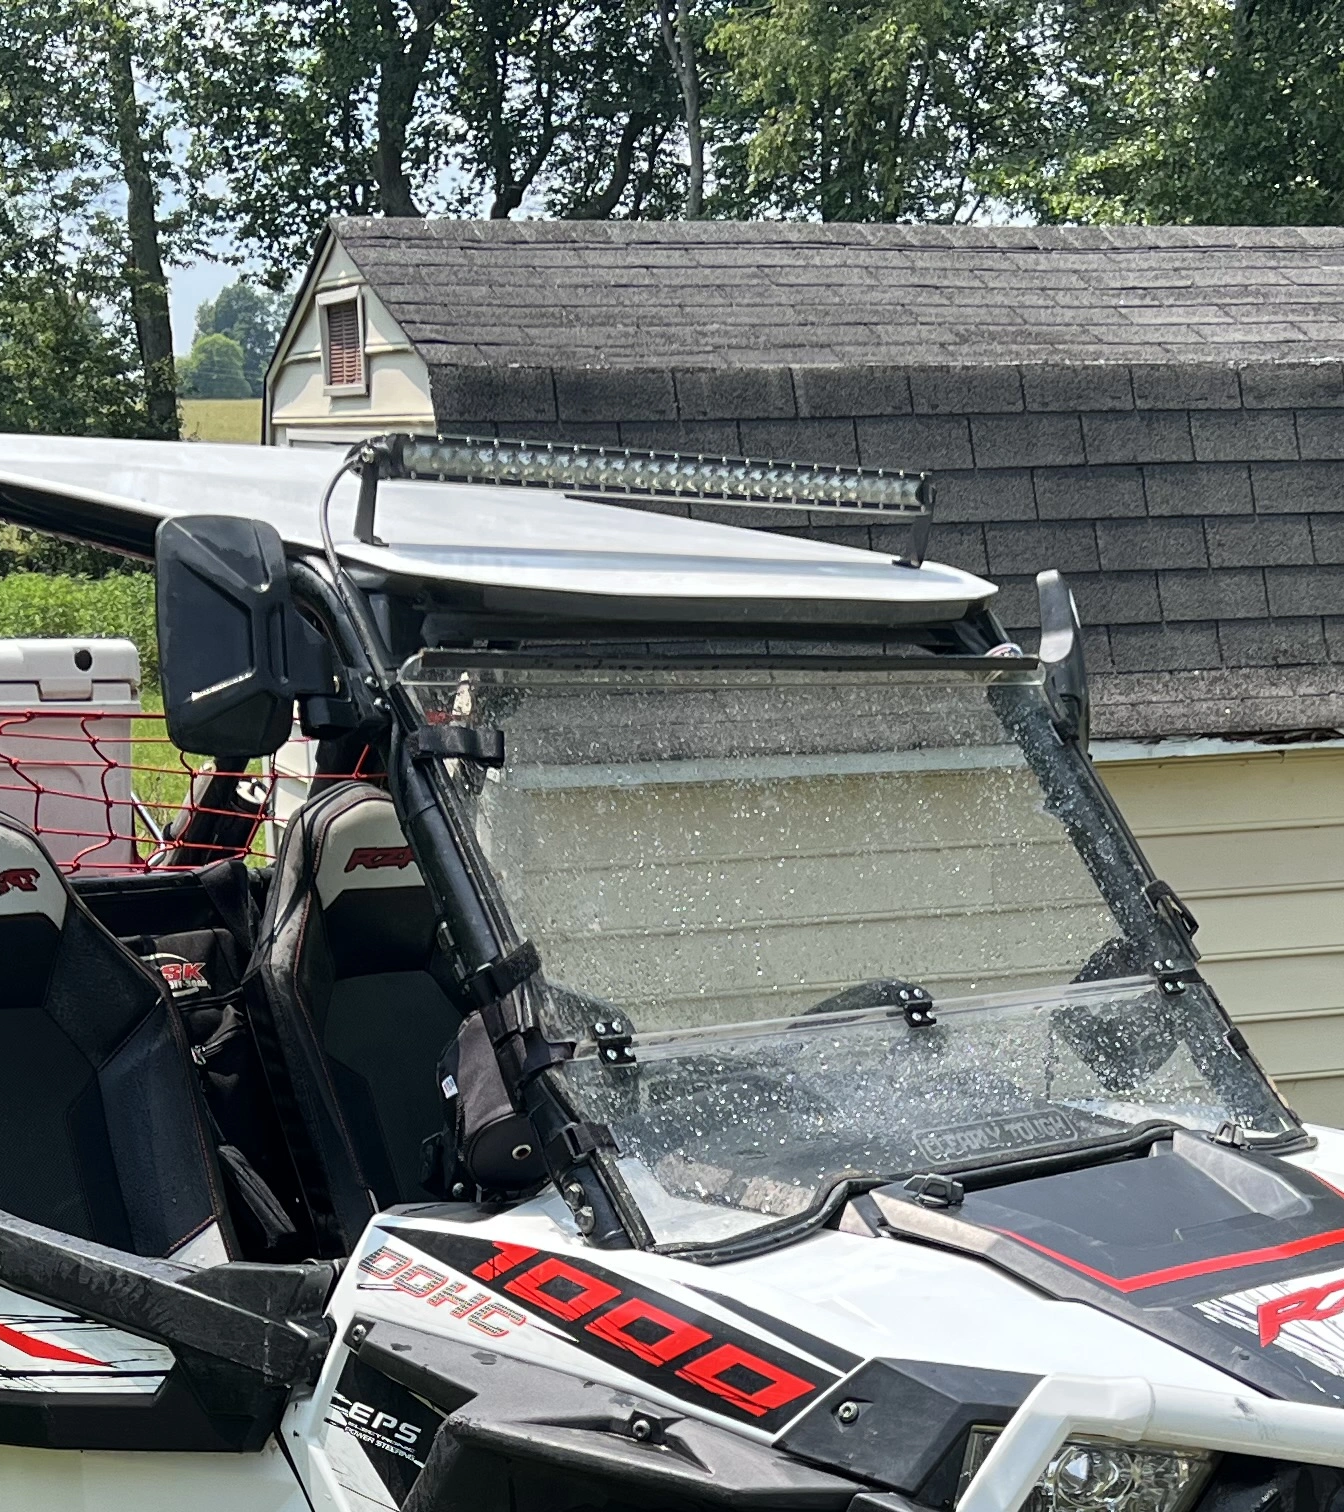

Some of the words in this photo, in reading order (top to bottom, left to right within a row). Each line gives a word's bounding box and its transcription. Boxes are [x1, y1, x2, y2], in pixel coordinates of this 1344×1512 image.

[921, 1125, 1000, 1159] CLEARLY
[1007, 1116, 1067, 1144] TOUGH
[358, 1245, 527, 1338] DOHC
[471, 1240, 817, 1417] 1000
[345, 1426, 375, 1444] POWER
[348, 1401, 422, 1444] EPS
